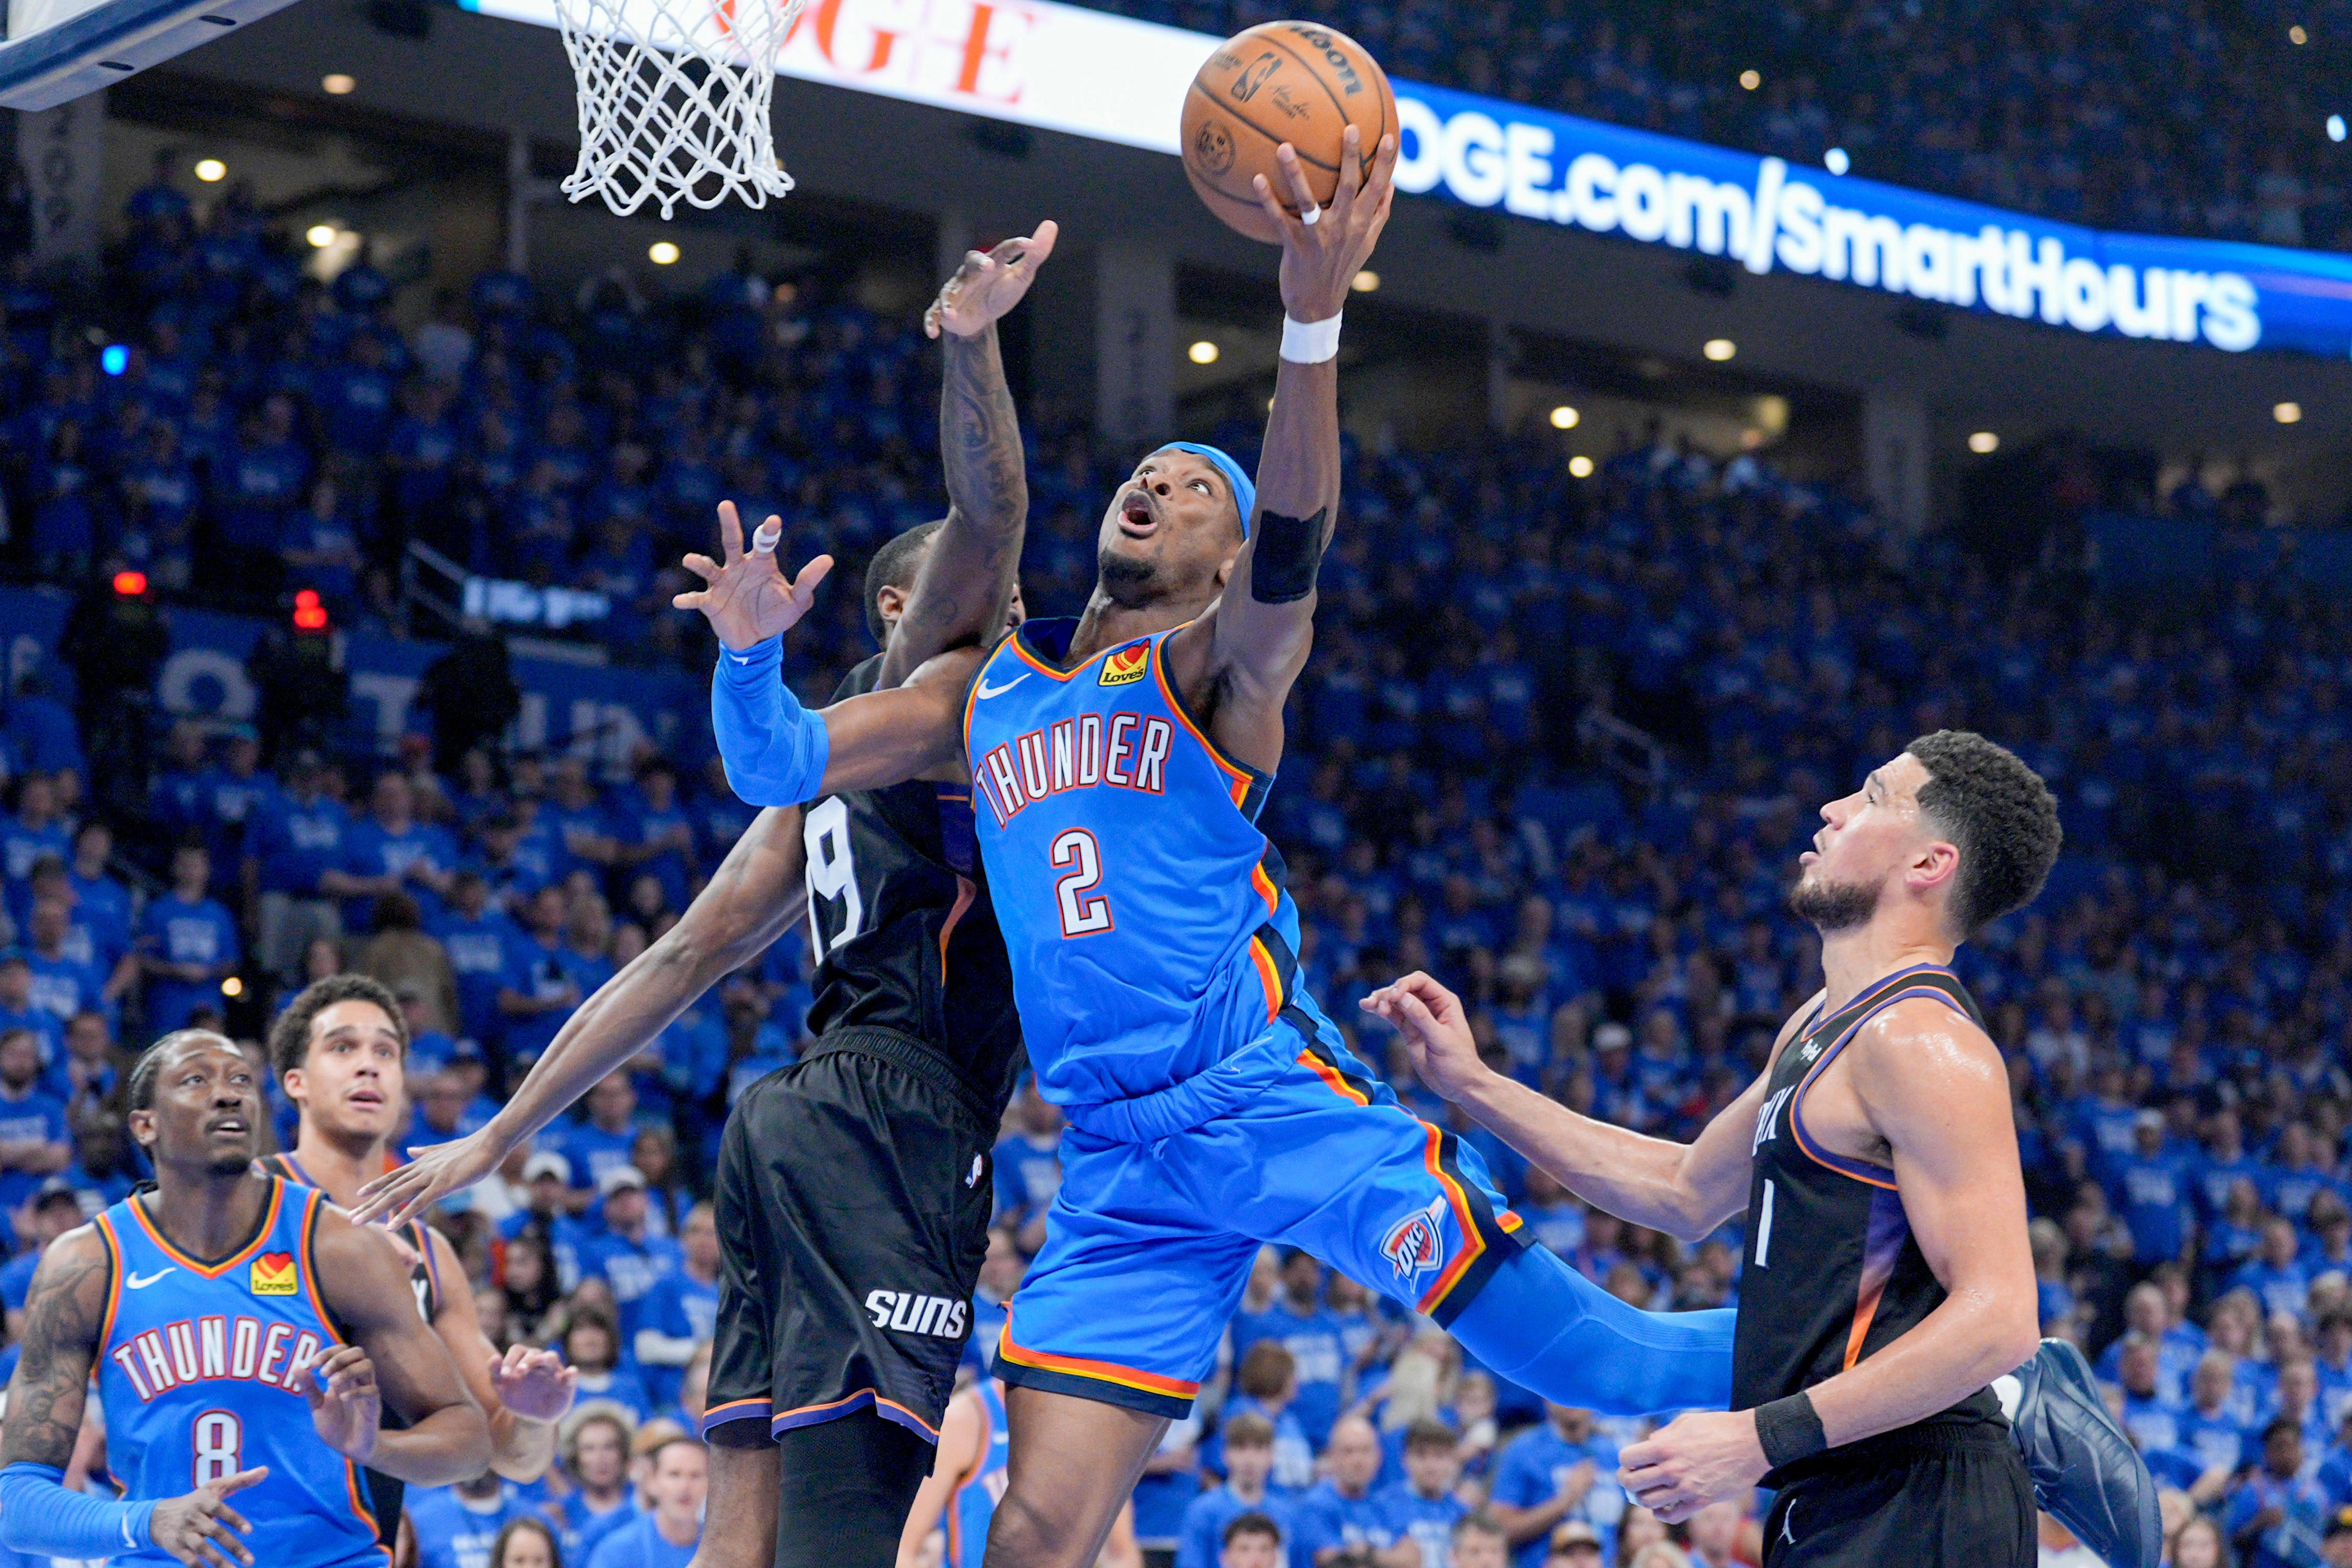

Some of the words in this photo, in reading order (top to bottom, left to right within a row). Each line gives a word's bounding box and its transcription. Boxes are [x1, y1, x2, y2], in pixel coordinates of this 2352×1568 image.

[1102, 665, 1144, 683] Love's
[975, 711, 1175, 832] THUNDER
[1051, 827, 1115, 939] 2
[1397, 1222, 1425, 1278] OKC
[1754, 1178, 1775, 1268] 1
[865, 1288, 967, 1339] SUNS
[112, 1315, 320, 1404] THUNDER
[192, 1409, 242, 1492] 8
